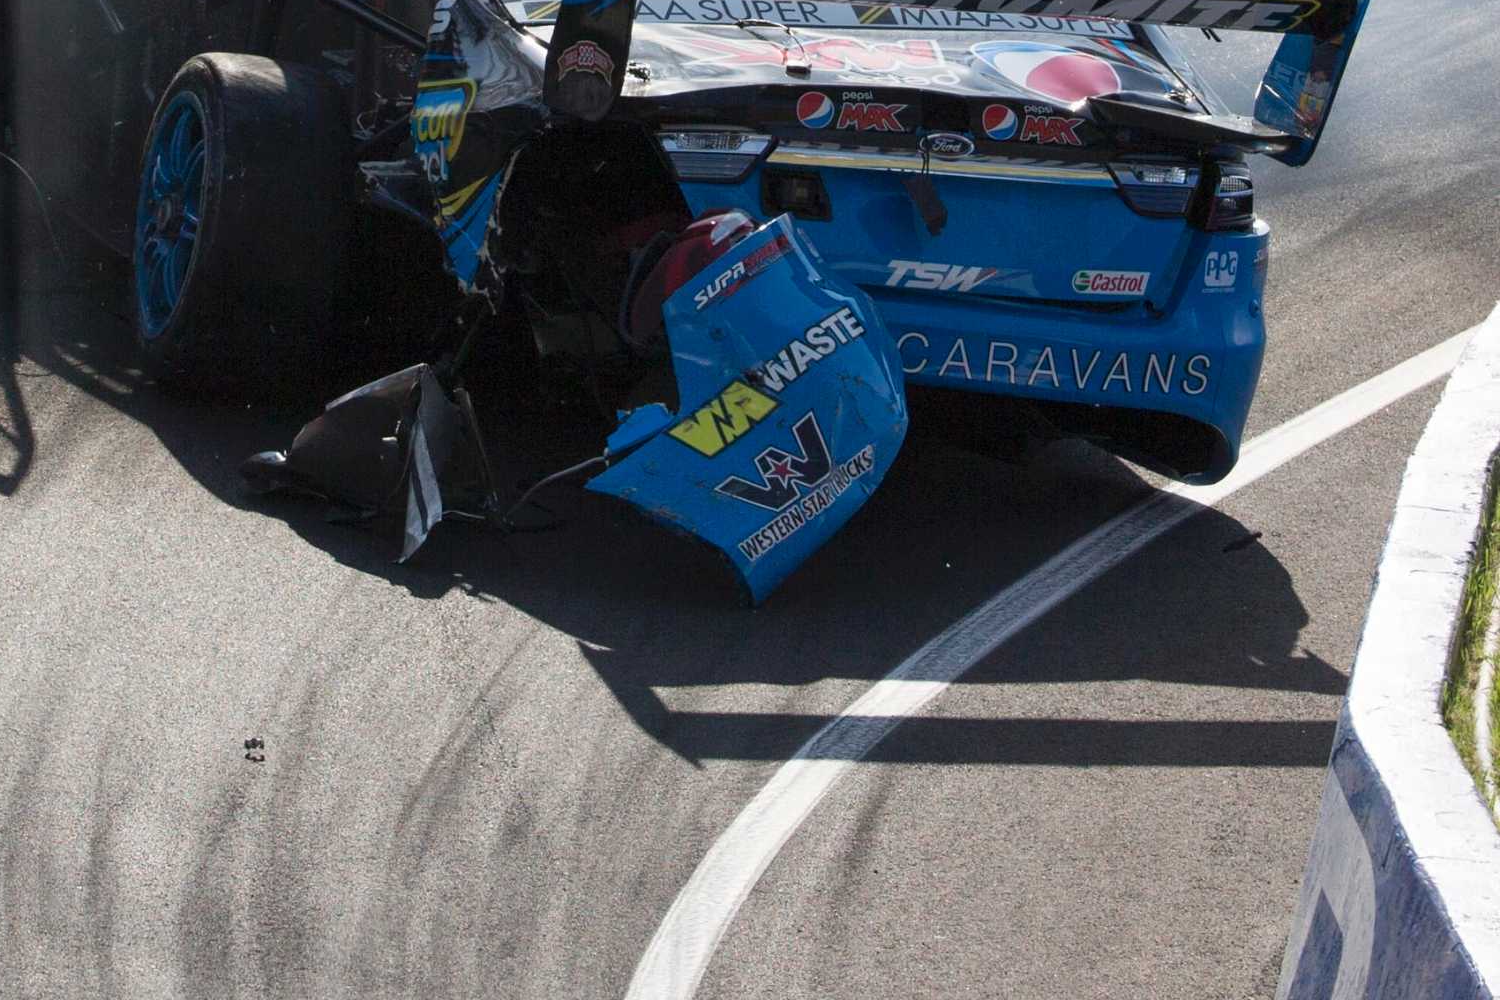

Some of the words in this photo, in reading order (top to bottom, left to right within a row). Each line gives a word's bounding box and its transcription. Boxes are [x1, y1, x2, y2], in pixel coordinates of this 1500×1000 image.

[636, 0, 696, 21] AA
[698, 0, 826, 23] SUPER
[842, 90, 874, 102] pepsi
[1024, 103, 1052, 115] pepsi
[837, 102, 908, 131] MAX
[1020, 115, 1085, 145] MAX
[931, 137, 963, 154] Ford
[885, 260, 996, 292] TSW
[1206, 251, 1237, 281] PPG
[1091, 274, 1144, 292] Castrol
[761, 307, 865, 392] WASTE
[898, 332, 1211, 395] CARAVANS
[739, 506, 804, 561] WESTERN
[803, 483, 835, 521] STAR
